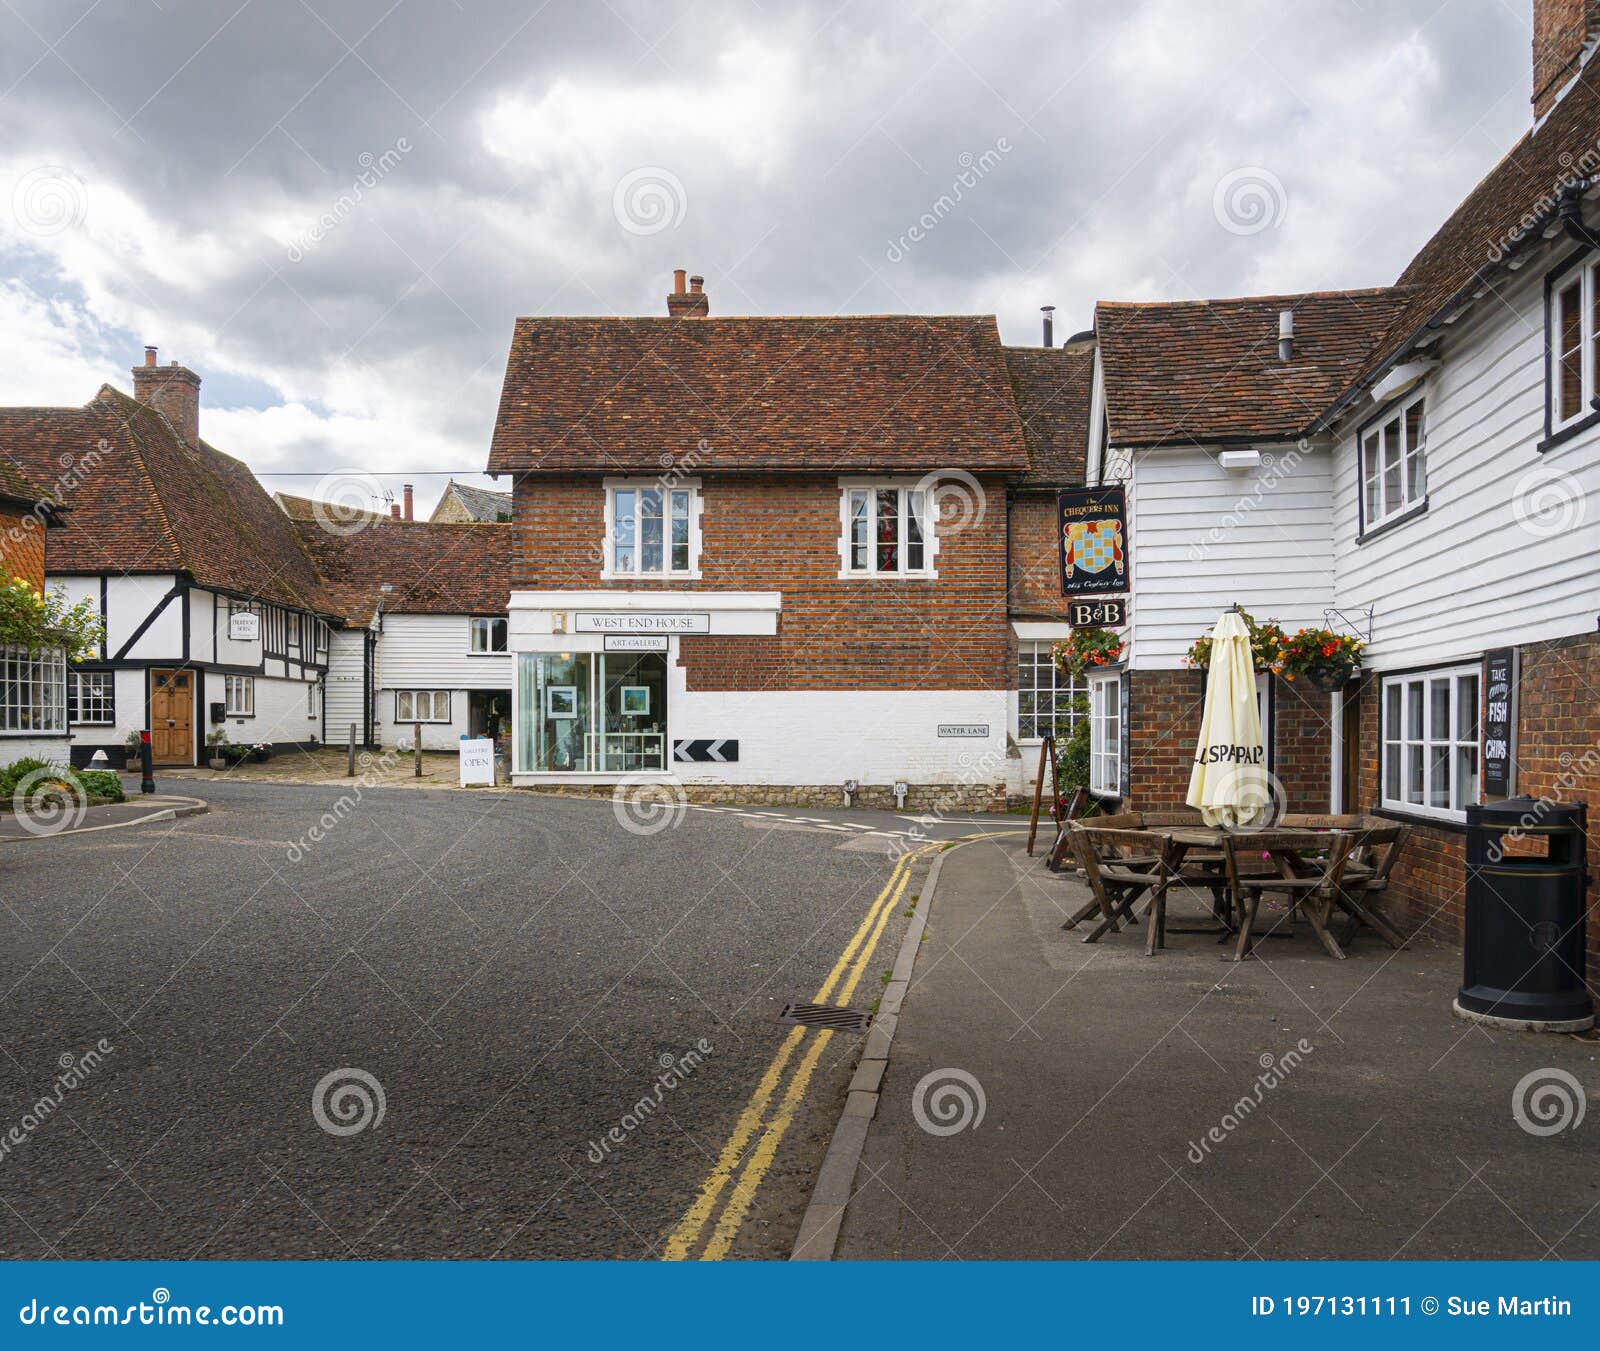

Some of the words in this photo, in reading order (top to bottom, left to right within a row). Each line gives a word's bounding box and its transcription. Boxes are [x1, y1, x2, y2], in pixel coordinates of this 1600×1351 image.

[1064, 505, 1102, 517] CHEQUERS
[1104, 504, 1119, 513] INN
[1074, 603, 1120, 625] B&B
[592, 617, 625, 628] WEST
[628, 617, 652, 628] END
[656, 618, 693, 628] HOUSE
[611, 639, 625, 647] ART
[628, 639, 662, 647] GALLERY
[1491, 668, 1507, 681] TAKE
[1489, 702, 1507, 722] FISH
[940, 727, 965, 735] WATER
[968, 727, 987, 735] LANE
[1485, 740, 1507, 759] CHIPS
[464, 758, 489, 767] OPEN
